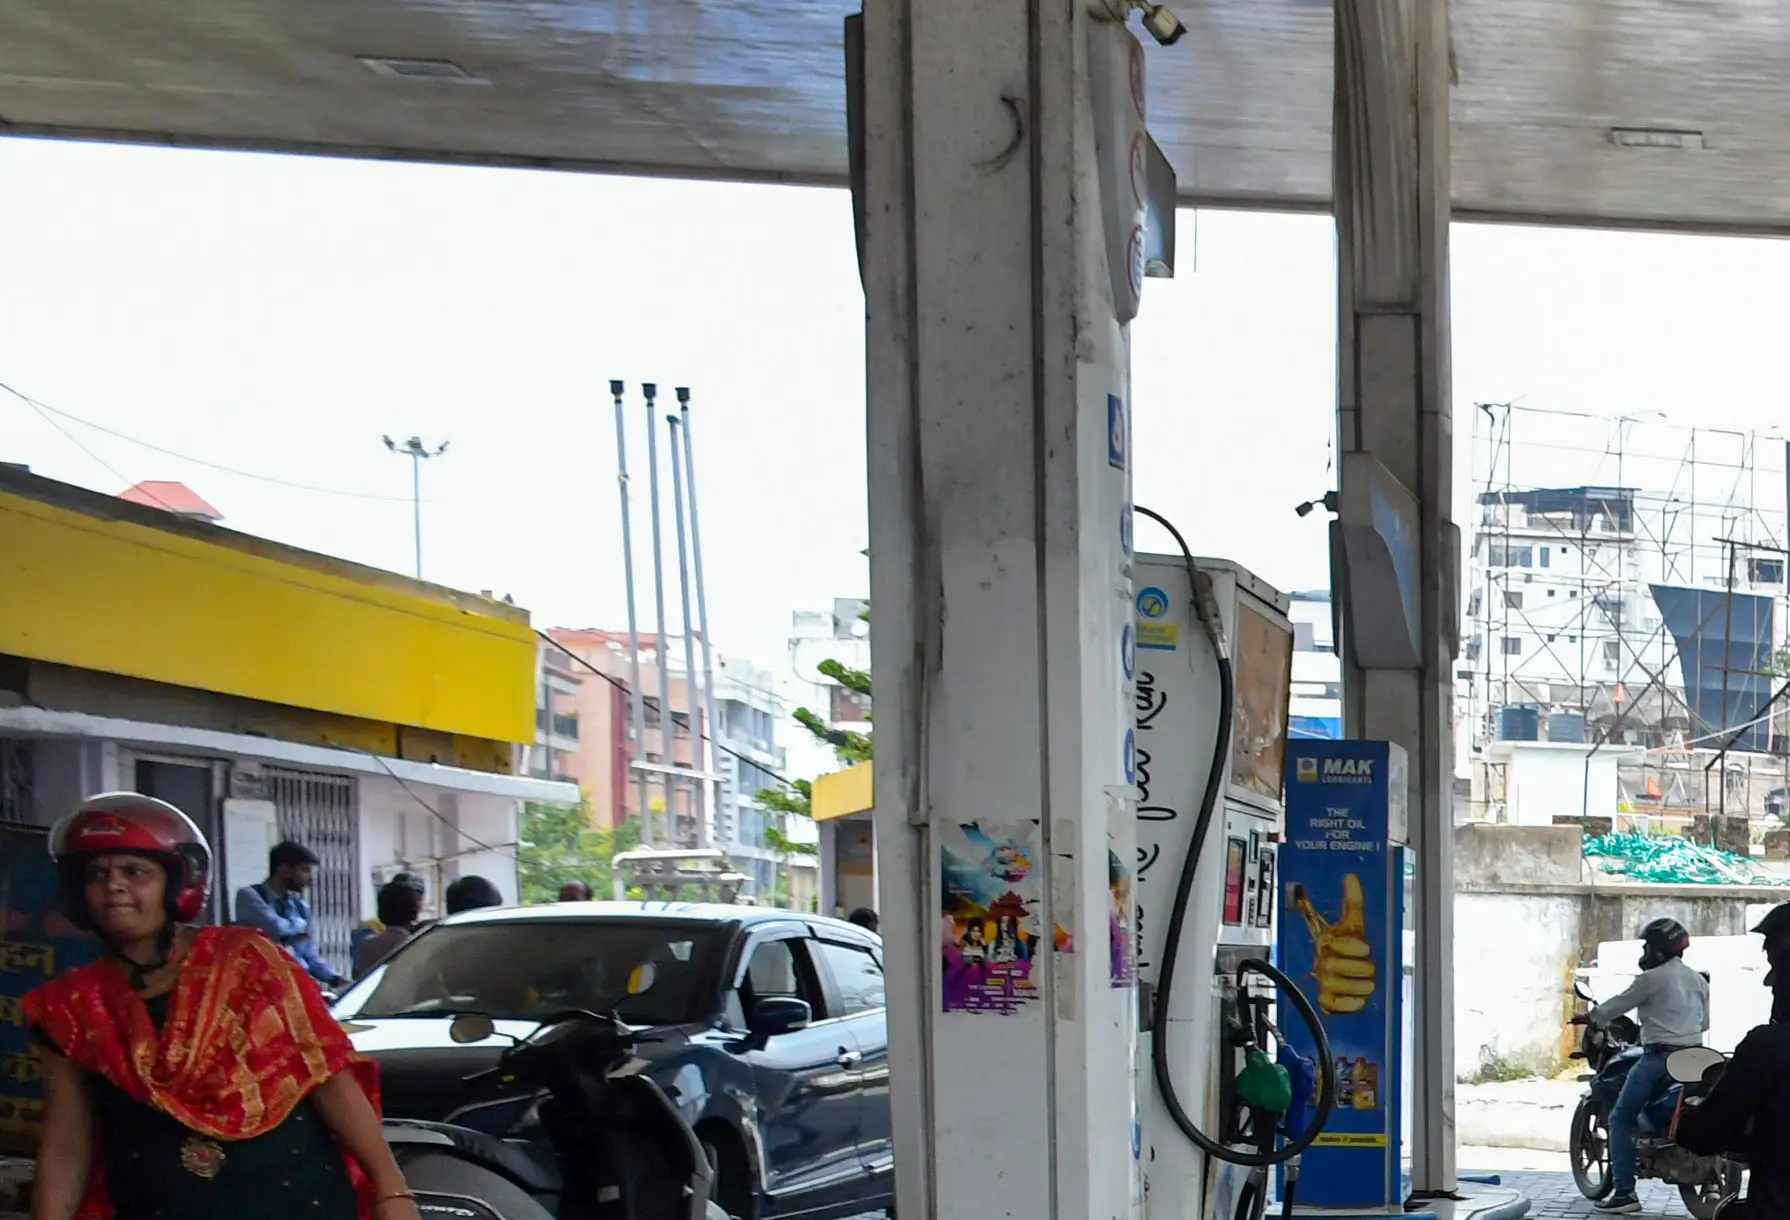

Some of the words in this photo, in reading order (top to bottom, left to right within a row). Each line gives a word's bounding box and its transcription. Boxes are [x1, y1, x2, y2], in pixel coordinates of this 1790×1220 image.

[1323, 758, 1374, 775] MAK
[1326, 807, 1350, 818] THE
[1309, 818, 1344, 829] RIGHT
[1347, 819, 1367, 830] OIL
[1325, 829, 1350, 840] FOR
[1295, 840, 1328, 850] YOUR
